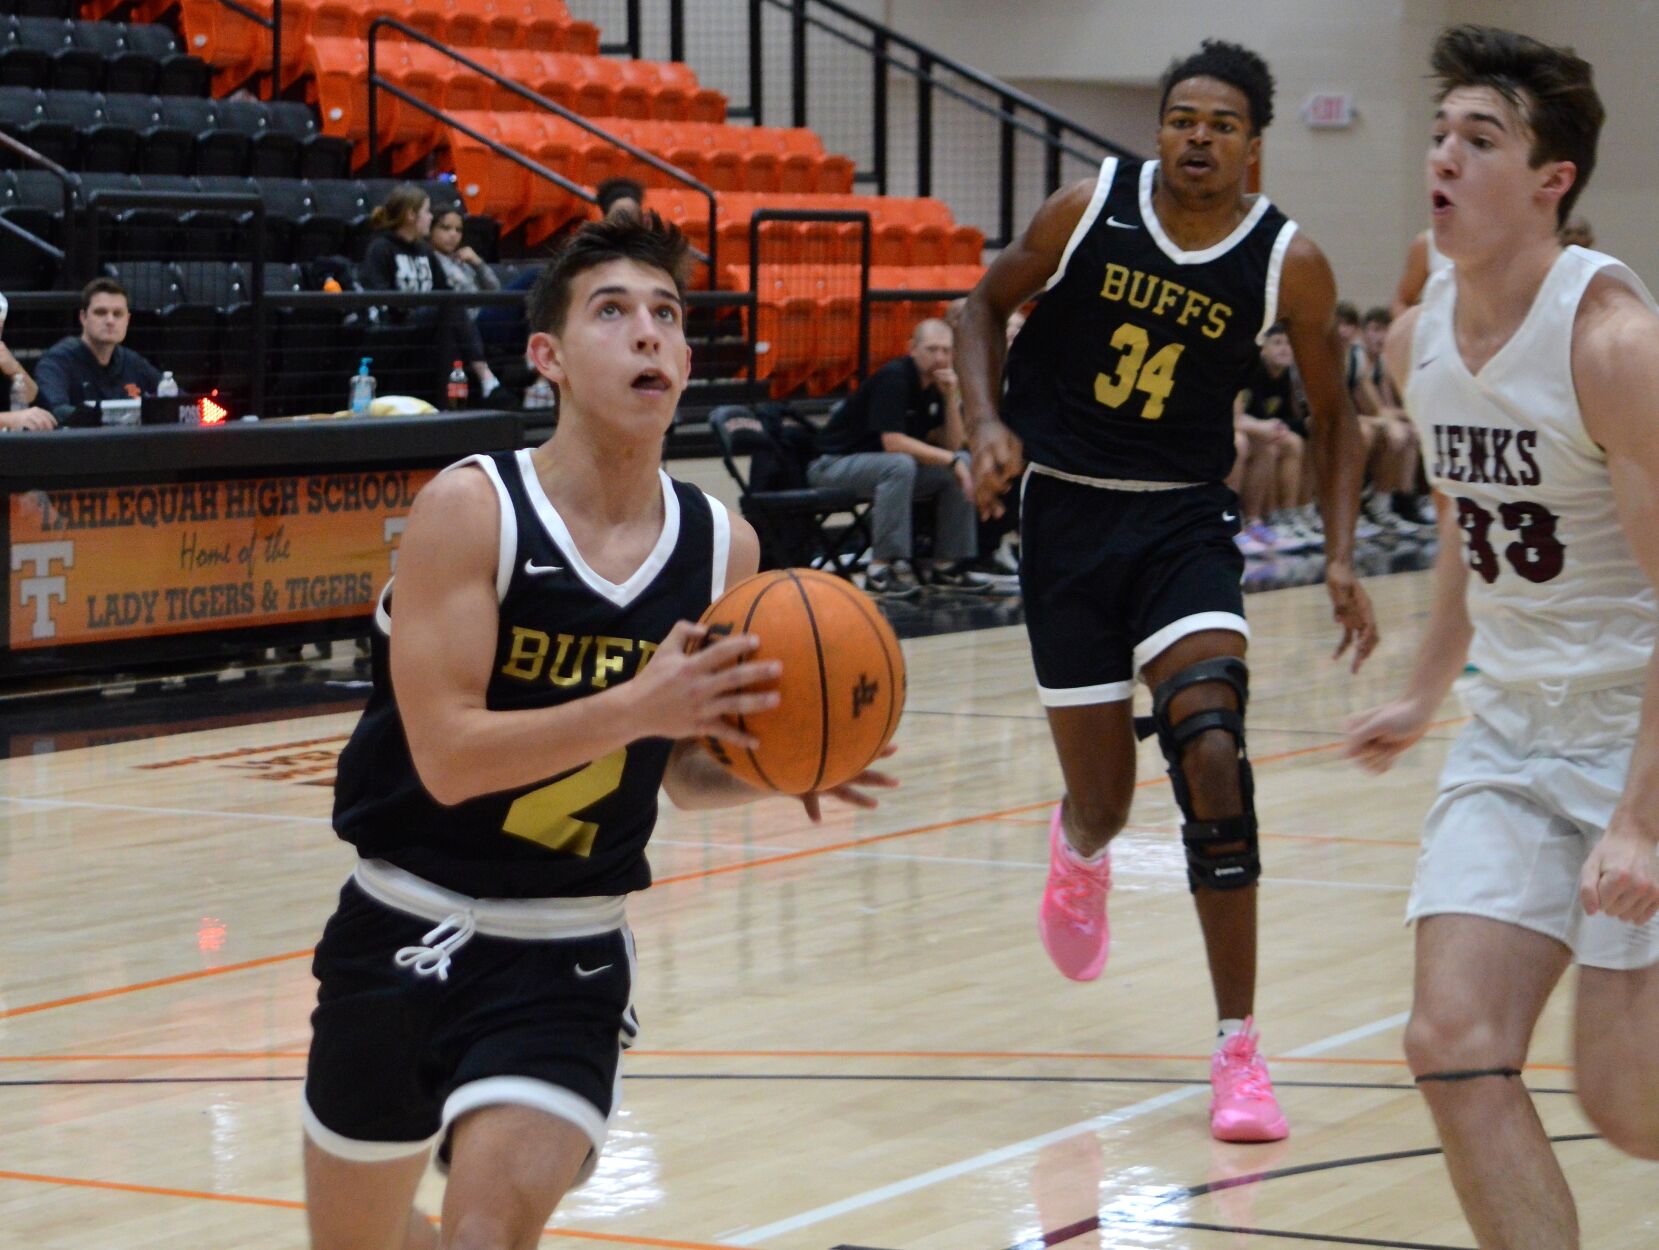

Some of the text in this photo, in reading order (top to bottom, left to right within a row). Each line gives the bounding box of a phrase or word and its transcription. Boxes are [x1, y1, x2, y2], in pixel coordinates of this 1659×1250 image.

[1100, 262, 1233, 340] BUFFS
[1093, 322, 1186, 421] 34
[1433, 424, 1541, 487] JENKS
[224, 477, 301, 520] HIGH
[306, 472, 415, 514] SCHOOL
[179, 524, 291, 580] Home of the
[86, 571, 373, 629] LADY TIGERS & TIGERS
[501, 625, 659, 688] BUF
[501, 747, 628, 858] 2
